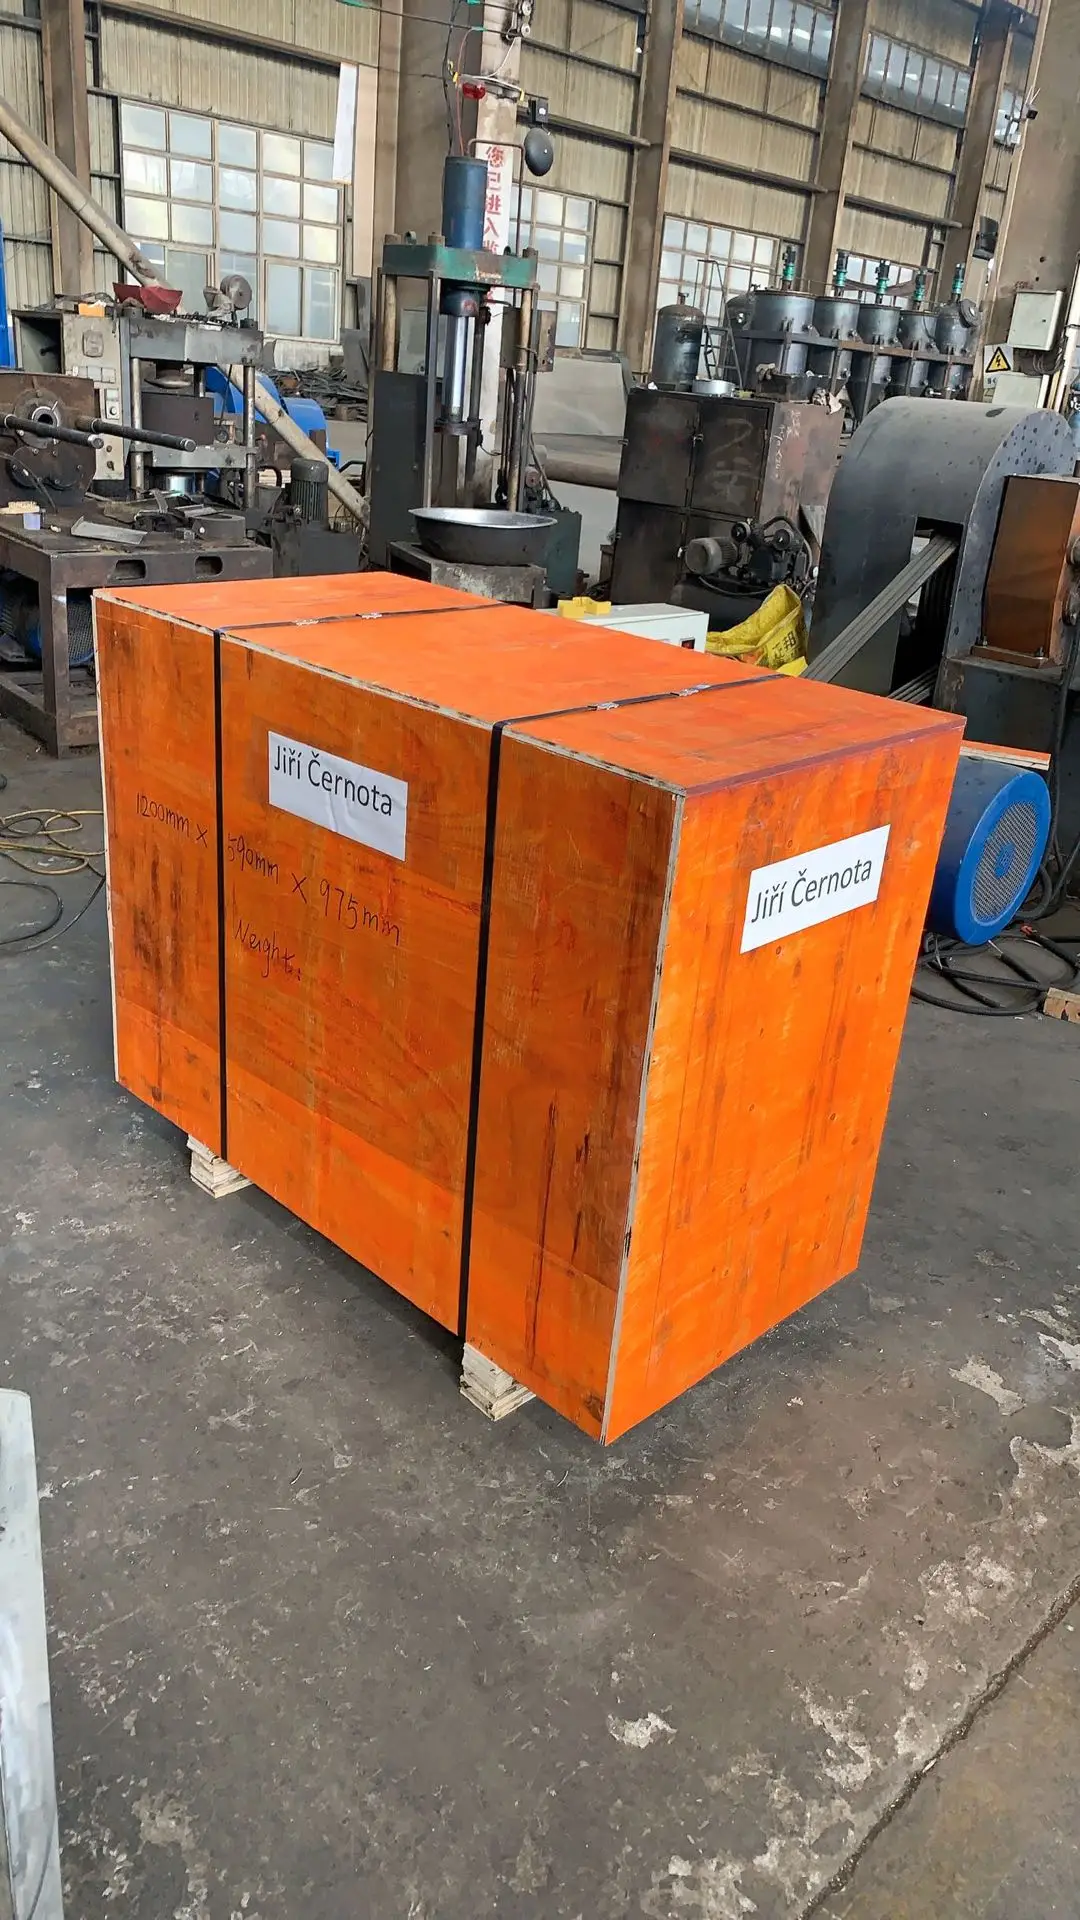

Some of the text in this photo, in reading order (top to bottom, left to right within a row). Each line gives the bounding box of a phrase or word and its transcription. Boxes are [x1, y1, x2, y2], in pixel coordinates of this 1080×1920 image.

[273, 745, 393, 816] Jiří Černota
[136, 793, 190, 838] 1200mm
[228, 833, 279, 884] 590mm
[319, 878, 400, 947] 975mm
[751, 859, 872, 923] Jiří Černota
